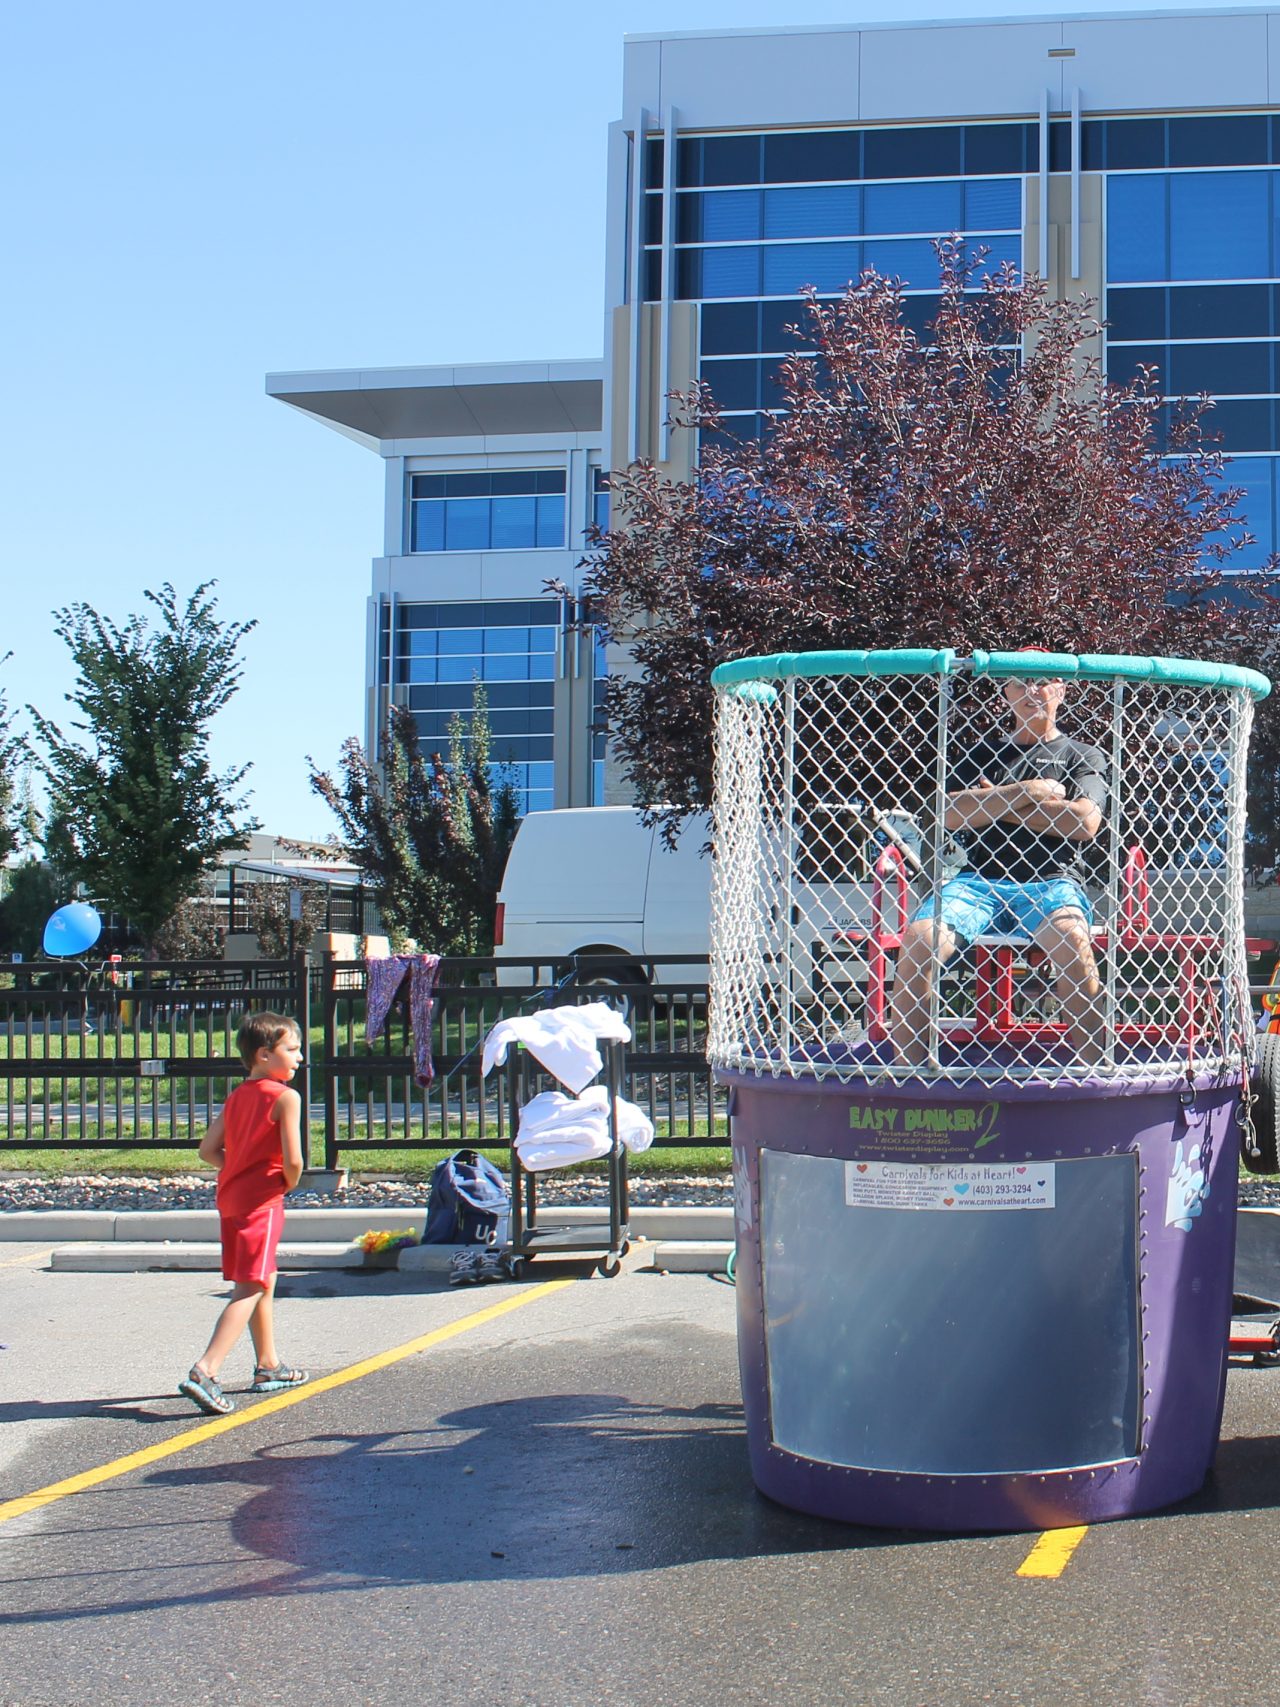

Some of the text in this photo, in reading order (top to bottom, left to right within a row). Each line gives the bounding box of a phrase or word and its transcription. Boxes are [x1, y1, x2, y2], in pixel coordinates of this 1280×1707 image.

[849, 1106, 898, 1130] EASY
[904, 1108, 977, 1131] DUNKER
[881, 1165, 1016, 1181] Carnivals for Kids at Heart!
[972, 1184, 1032, 1196] (403) 293-3294
[958, 1197, 1046, 1207] www.carnivalsatheart.com
